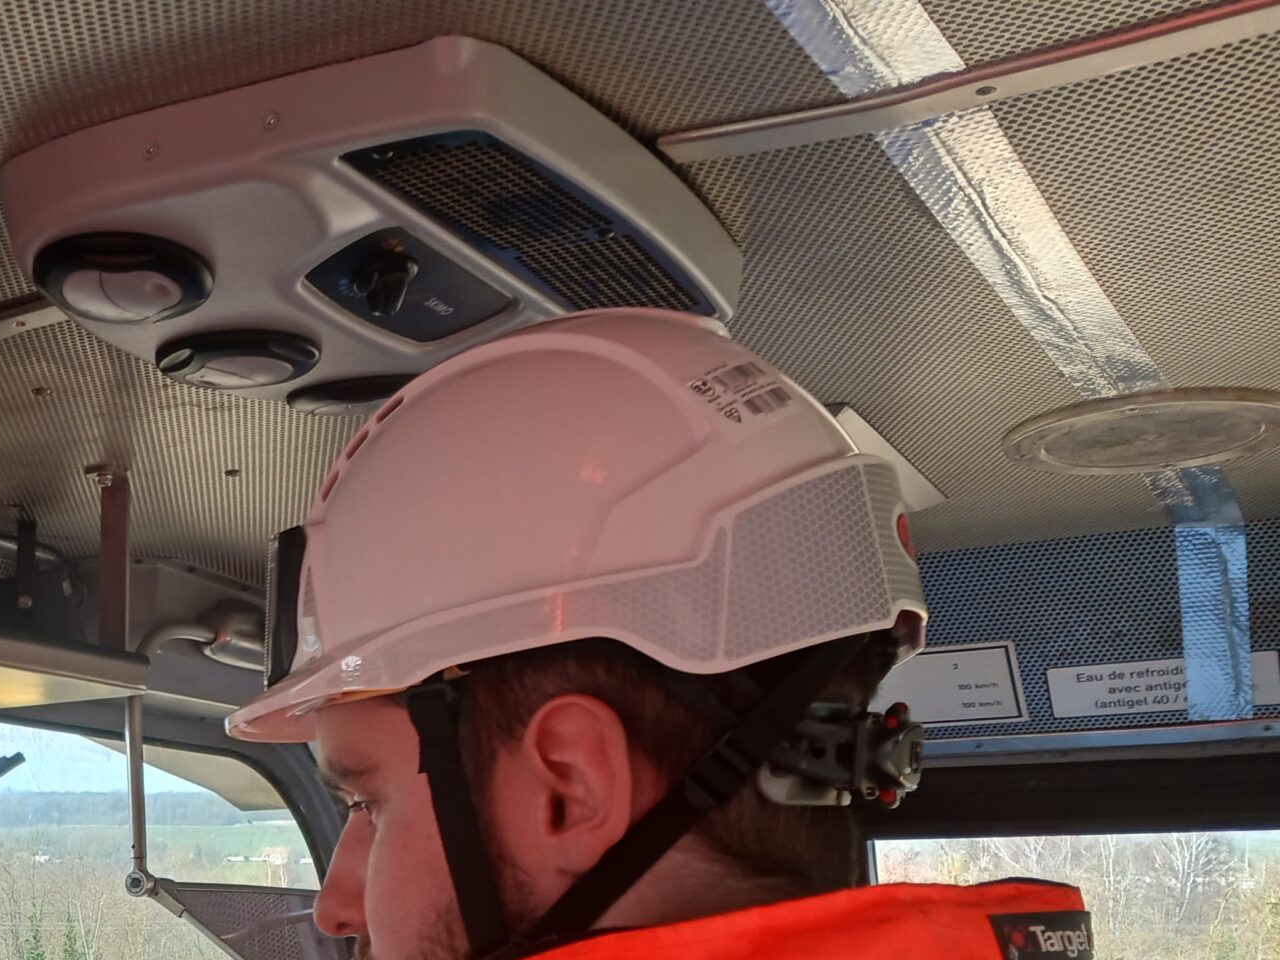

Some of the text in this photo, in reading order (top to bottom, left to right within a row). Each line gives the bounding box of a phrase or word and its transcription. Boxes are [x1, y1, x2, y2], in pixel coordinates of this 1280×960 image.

[1075, 672, 1104, 683] Eau
[1107, 670, 1126, 681] de
[1107, 685, 1142, 695] avec
[1094, 695, 1149, 710] (antigel
[1151, 694, 1170, 705] 40
[1028, 922, 1090, 958] Target
